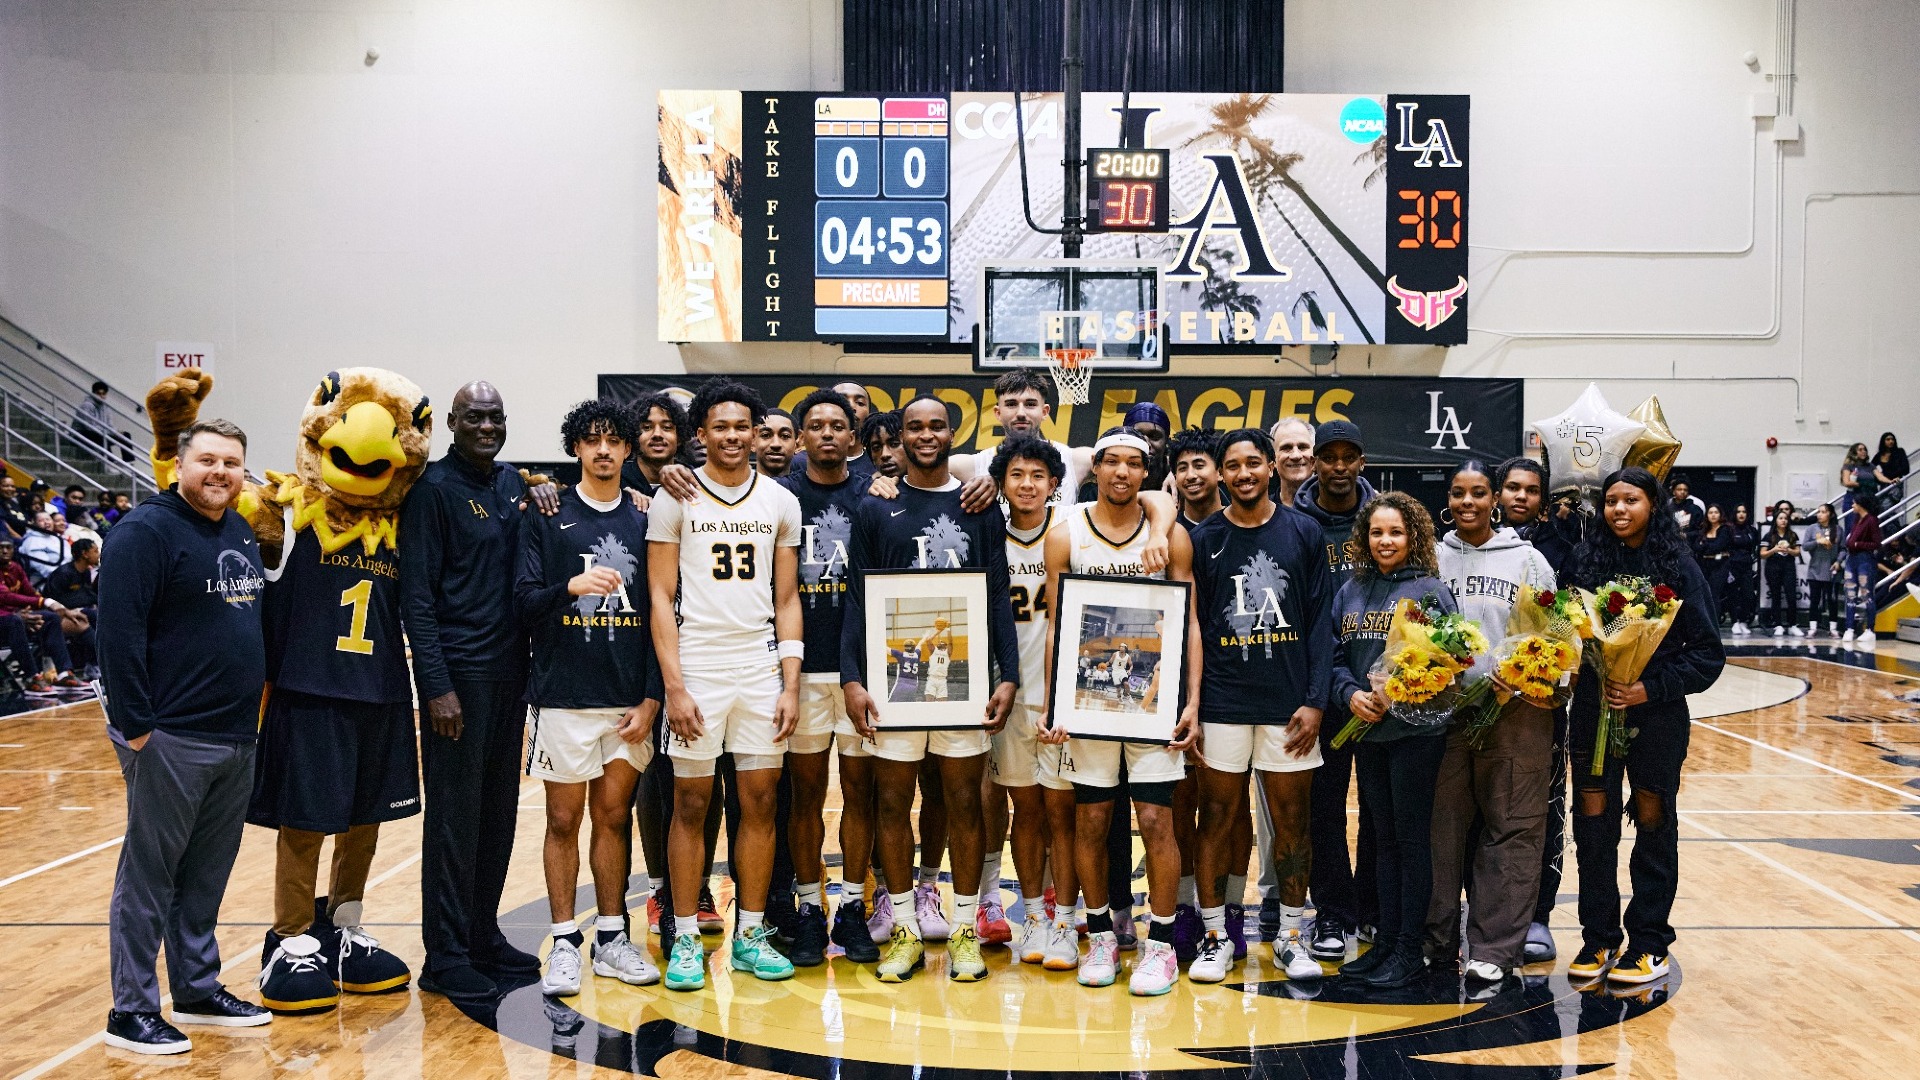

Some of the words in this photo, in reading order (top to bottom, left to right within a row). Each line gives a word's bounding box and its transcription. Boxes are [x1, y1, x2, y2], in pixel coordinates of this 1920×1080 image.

[818, 104, 831, 115] LA
[928, 103, 946, 117] DH
[685, 104, 715, 155] LA
[765, 98, 780, 178] TAKE
[1344, 119, 1384, 133] NCAA
[1395, 102, 1463, 168] LA
[835, 146, 859, 188] 0
[903, 146, 926, 189] 0
[1096, 153, 1160, 177] 20:00
[685, 170, 715, 247] ARE
[1105, 183, 1153, 225] 30
[1397, 189, 1461, 249] 30
[821, 216, 942, 265] 04:53
[765, 200, 780, 337] FLIGHT
[685, 262, 715, 324] WE
[842, 282, 920, 303] PREGAME
[164, 353, 205, 368] EXIT
[1424, 391, 1473, 450] LA
[468, 499, 490, 519] LA
[691, 520, 717, 533] Los
[719, 520, 773, 536] Angeles
[319, 554, 350, 567] Los
[711, 542, 756, 581] 33
[206, 578, 229, 593] Los
[228, 574, 265, 593] Angeles
[1465, 575, 1520, 606] STATE
[1229, 574, 1292, 631] LA
[335, 579, 374, 656] 1
[1220, 631, 1299, 647] BASKETBALL
[1356, 631, 1389, 641] ANGELE
[902, 661, 919, 675] 55
[538, 750, 555, 772] LA
[1062, 752, 1077, 773] LA
[390, 797, 416, 809] GOLDEN
